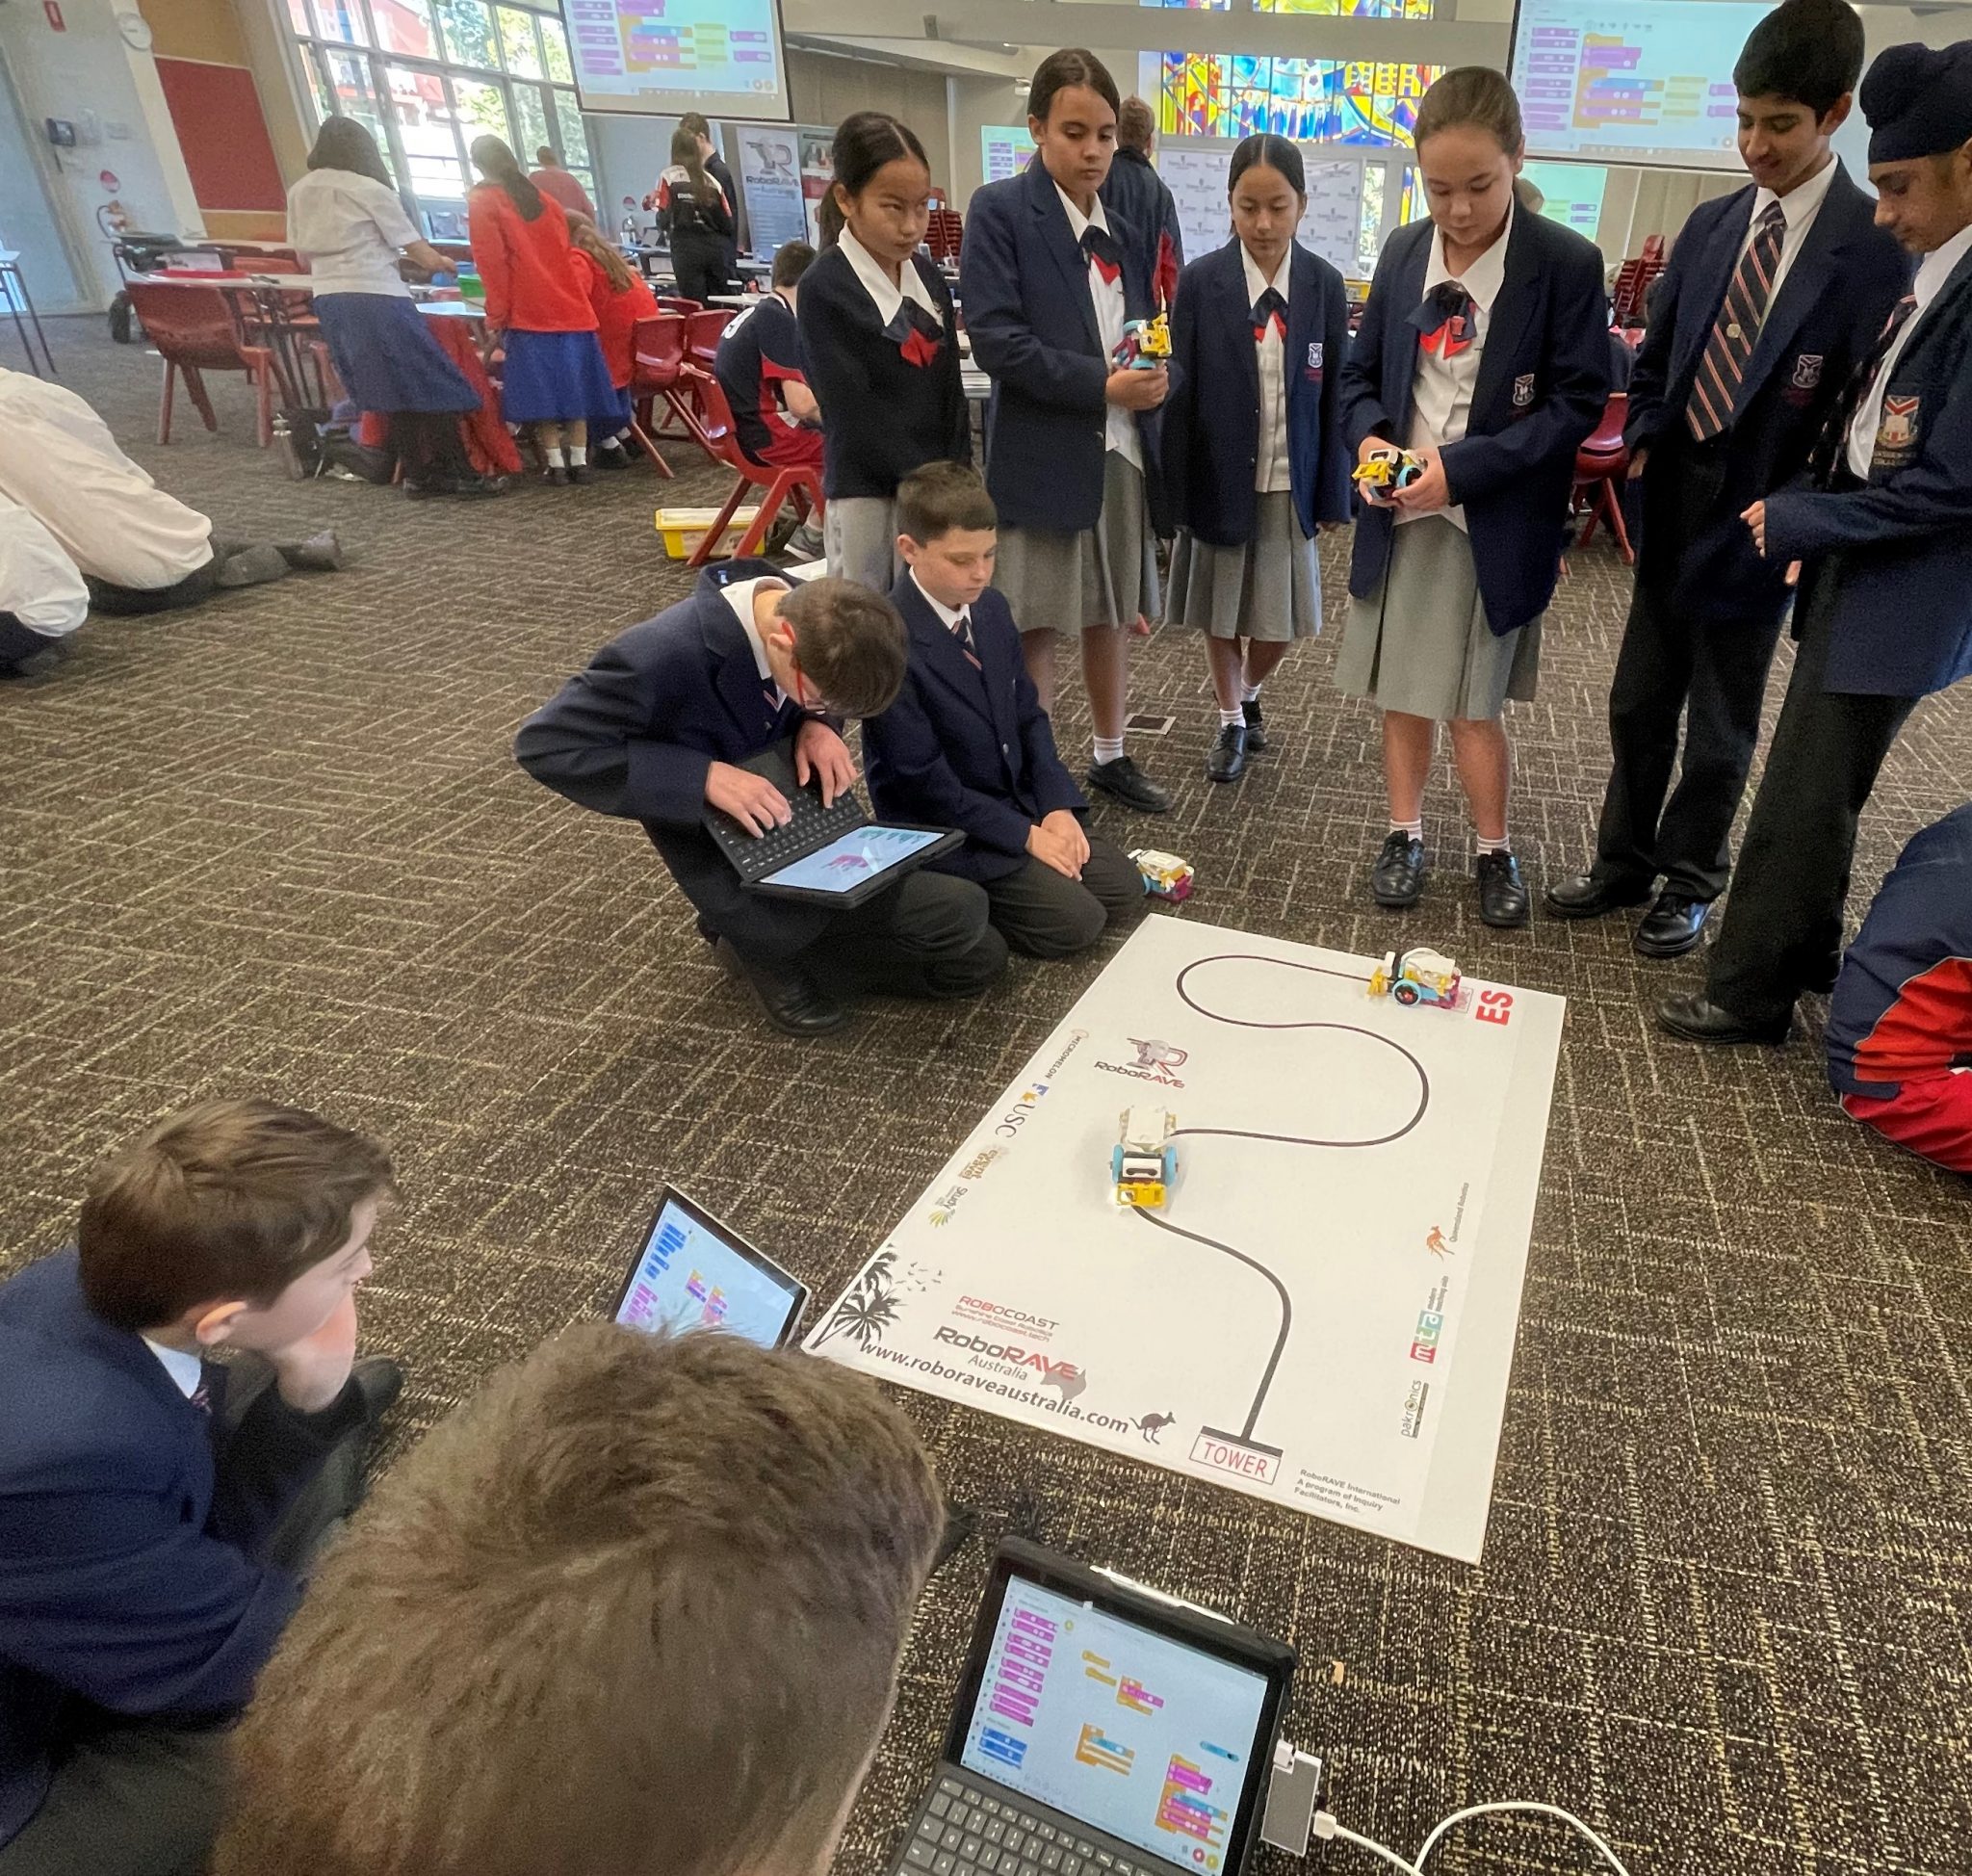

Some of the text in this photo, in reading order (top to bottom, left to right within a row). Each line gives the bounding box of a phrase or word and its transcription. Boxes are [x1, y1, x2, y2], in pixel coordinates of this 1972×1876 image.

[1475, 990, 1514, 1026] ES
[1046, 1035, 1082, 1080] MICROMELON
[1094, 1060, 1185, 1089] RoboRAVE
[995, 1104, 1036, 1137] USC
[959, 1295, 1060, 1330] ROBOCOAST
[933, 1325, 1079, 1381] RoboRAVE
[1413, 1313, 1440, 1362] mta
[968, 1353, 1028, 1381] Australia
[860, 1342, 1129, 1434] www.roboraveaustralia.com
[1203, 1441, 1268, 1478] TOWER
[1300, 1469, 1401, 1505] RoboRAVE International
[1305, 1481, 1341, 1498] program
